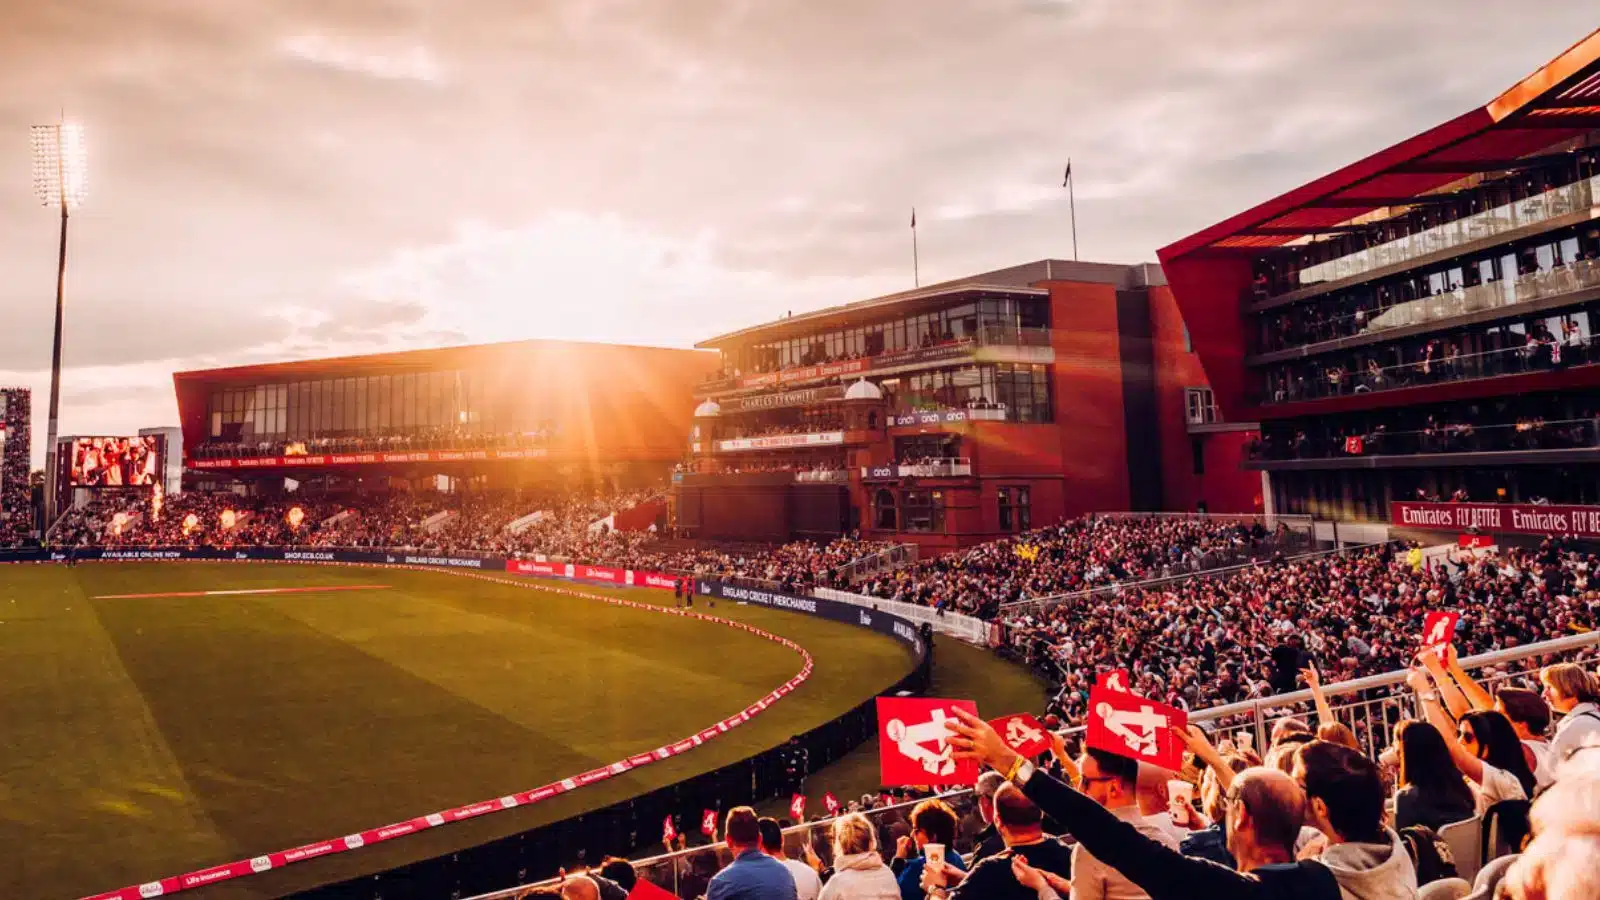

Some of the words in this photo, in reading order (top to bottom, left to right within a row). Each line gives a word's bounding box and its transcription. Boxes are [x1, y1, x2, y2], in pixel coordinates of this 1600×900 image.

[740, 396, 772, 409] CHARLES
[946, 411, 966, 421] cinch
[1402, 506, 1452, 525] Emirates
[1456, 508, 1469, 526] FLY
[1471, 508, 1501, 528] BETTER
[1512, 509, 1568, 531] Emirates
[1572, 511, 1587, 532] FLY
[722, 586, 749, 600] ENGLAND
[749, 590, 772, 605] CRICKET
[773, 593, 817, 613] MERCHANDISE
[703, 812, 714, 832] 4
[186, 876, 200, 885] Life
